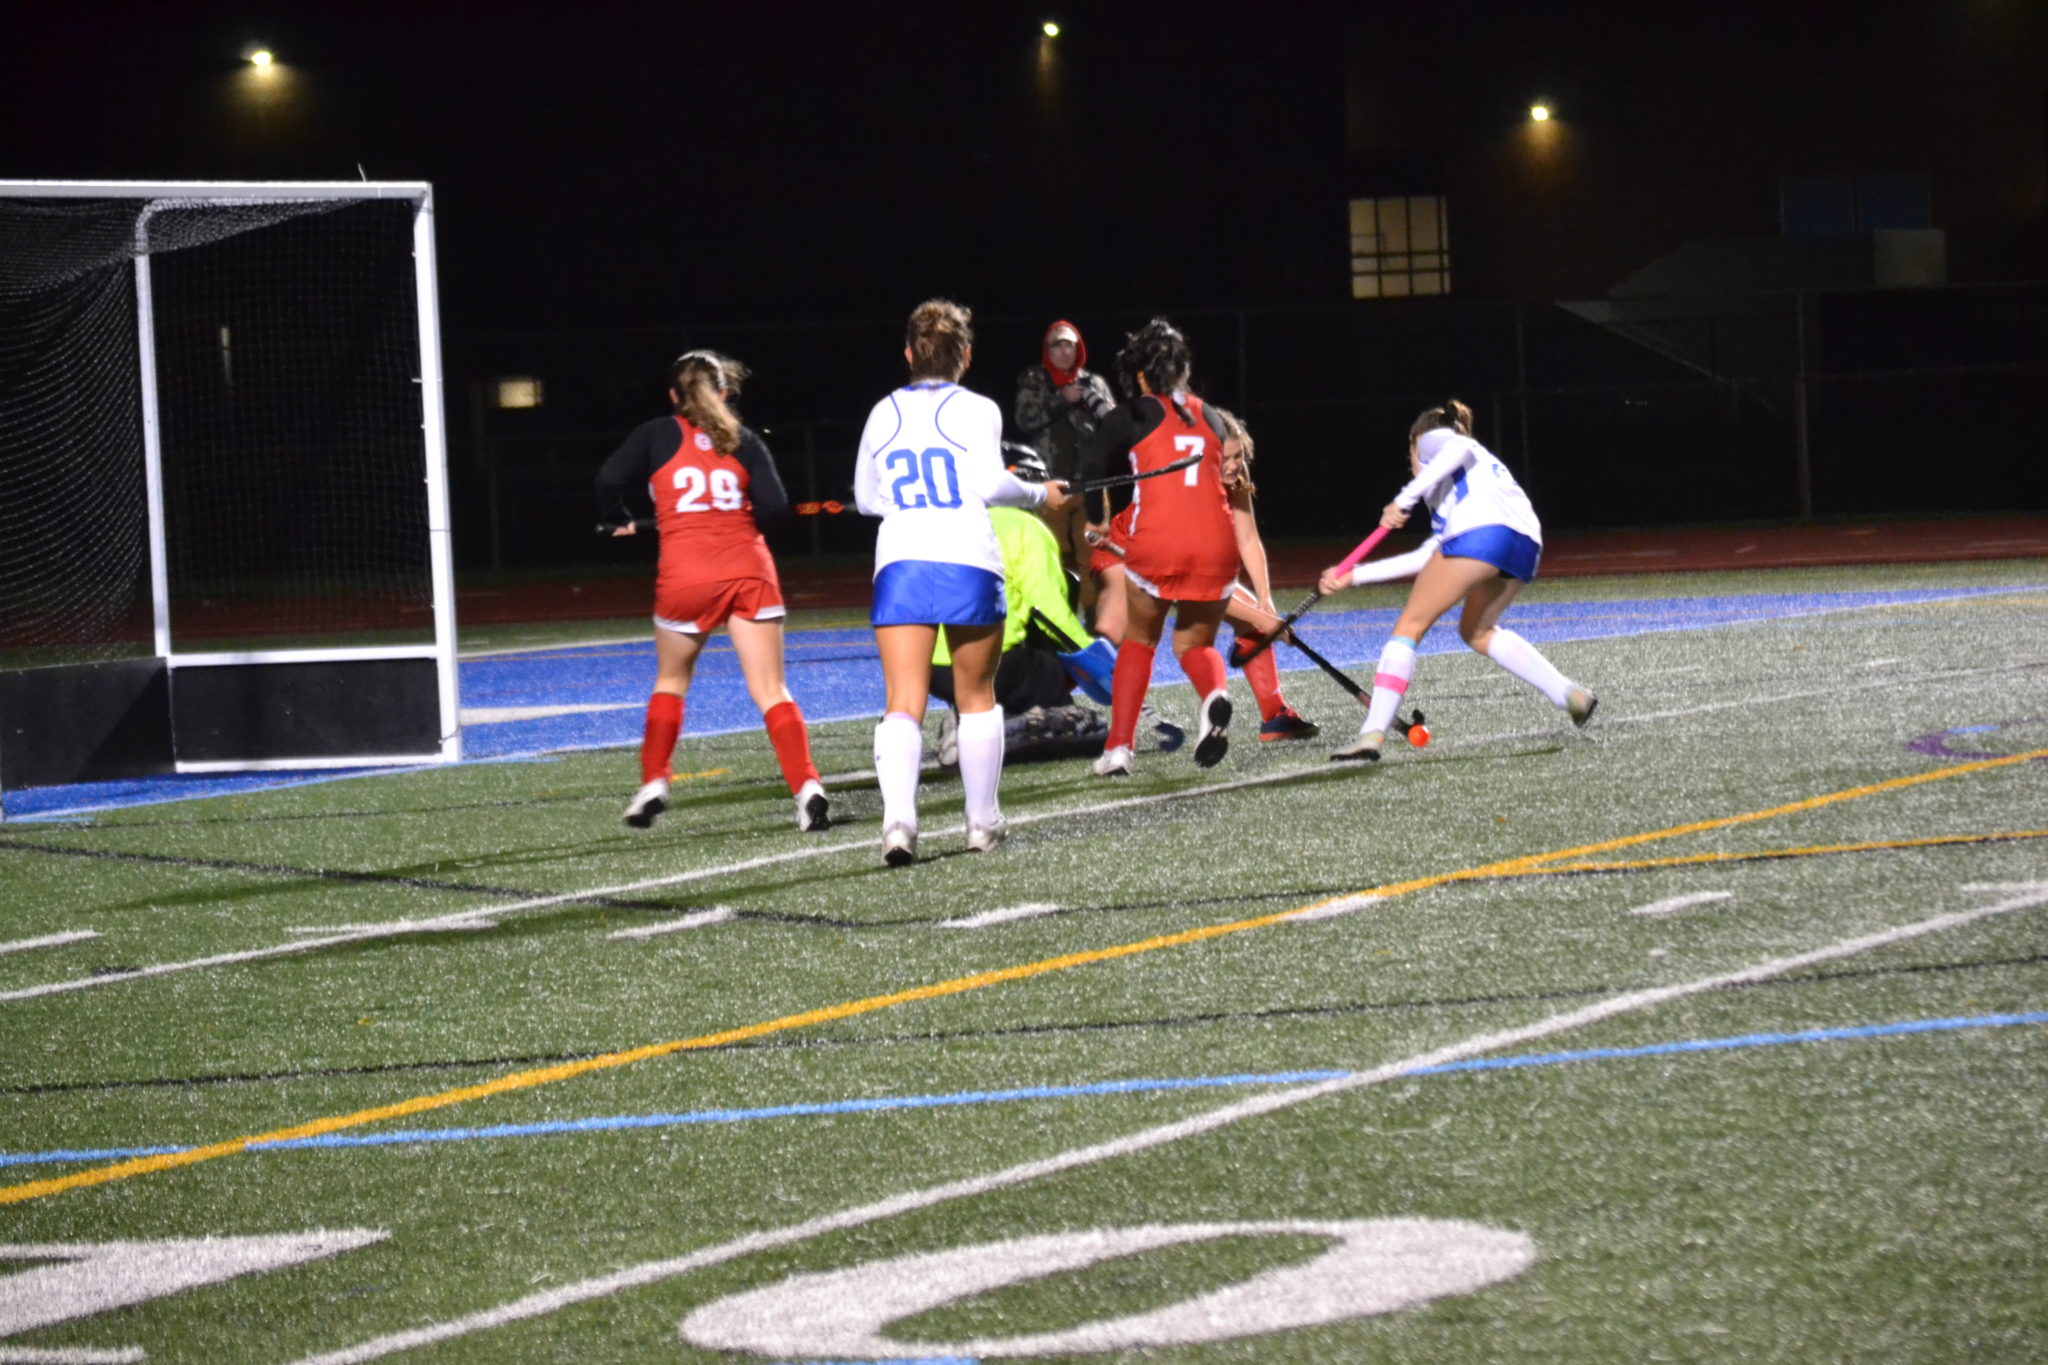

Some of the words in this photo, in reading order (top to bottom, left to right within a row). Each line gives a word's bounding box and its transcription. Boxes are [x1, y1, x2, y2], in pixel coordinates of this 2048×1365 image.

[885, 447, 963, 510] 20
[1174, 435, 1205, 486] 7
[673, 466, 743, 512] 29
